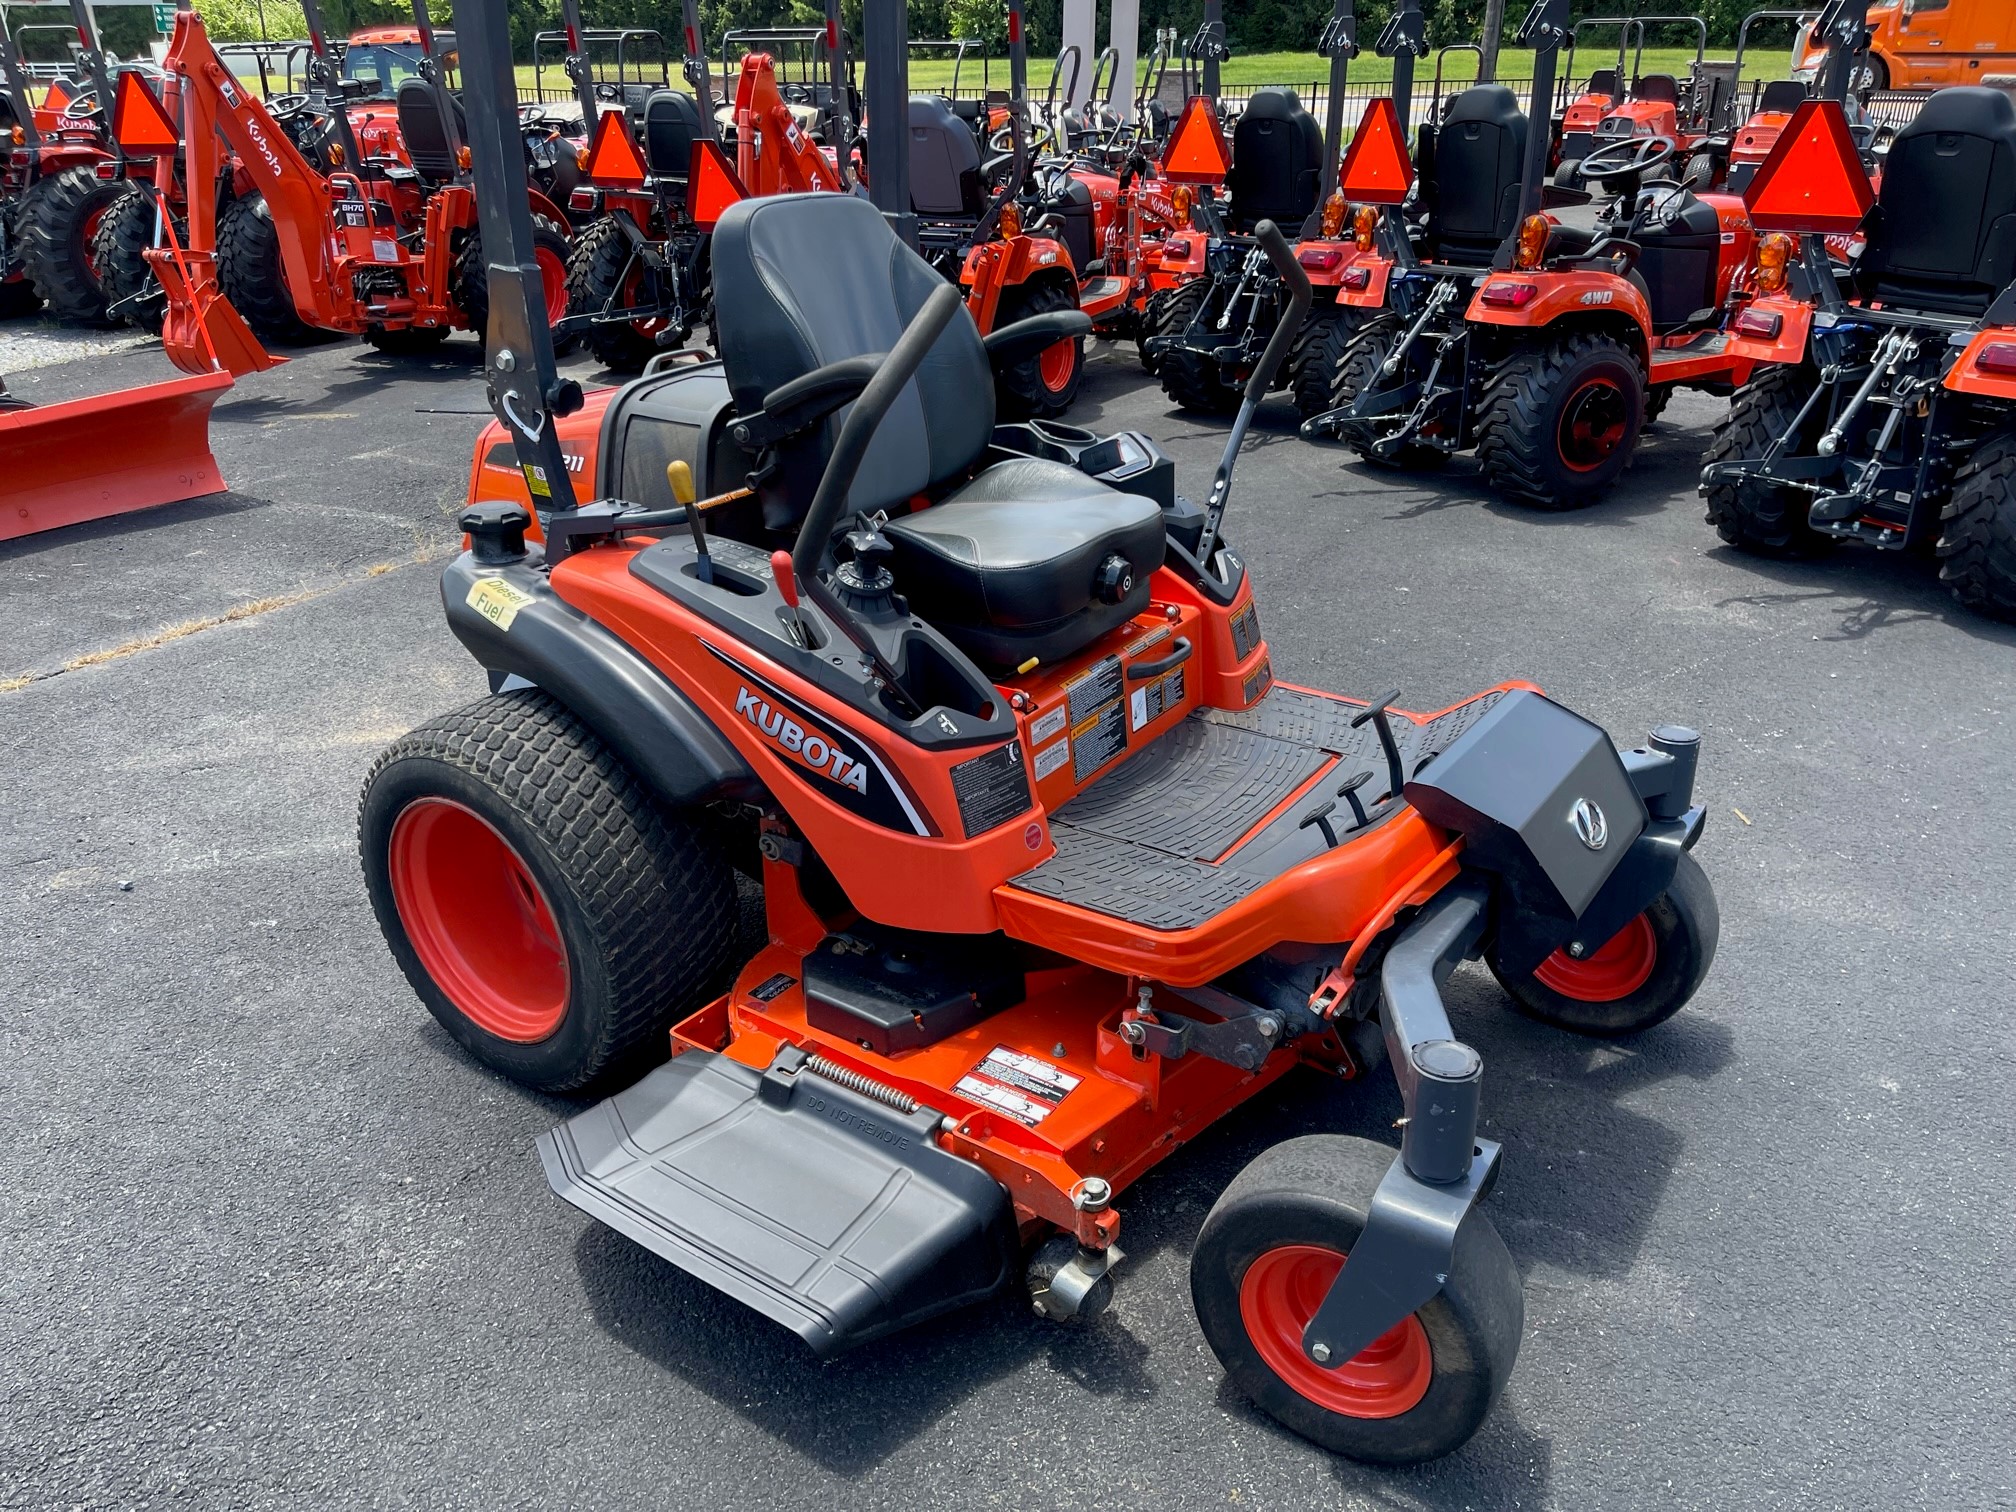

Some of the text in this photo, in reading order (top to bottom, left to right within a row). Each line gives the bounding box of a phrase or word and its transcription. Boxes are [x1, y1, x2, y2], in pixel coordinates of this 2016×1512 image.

[247, 118, 282, 177] Kubota
[342, 204, 365, 212] BH70
[1151, 196, 1174, 218] Kubota
[1039, 252, 1057, 265] 4WD
[1580, 290, 1614, 305] 4WD
[486, 580, 530, 605] Diesel
[476, 592, 505, 622] Fuel
[735, 686, 867, 796] KUBOTA
[956, 757, 980, 771] IMPORTANT
[964, 787, 990, 802] IMPORTANTE
[1029, 1055, 1057, 1070] PELIGRO
[1000, 1085, 1028, 1101] DANGER
[807, 1096, 910, 1151] DO NOT REMOVE
